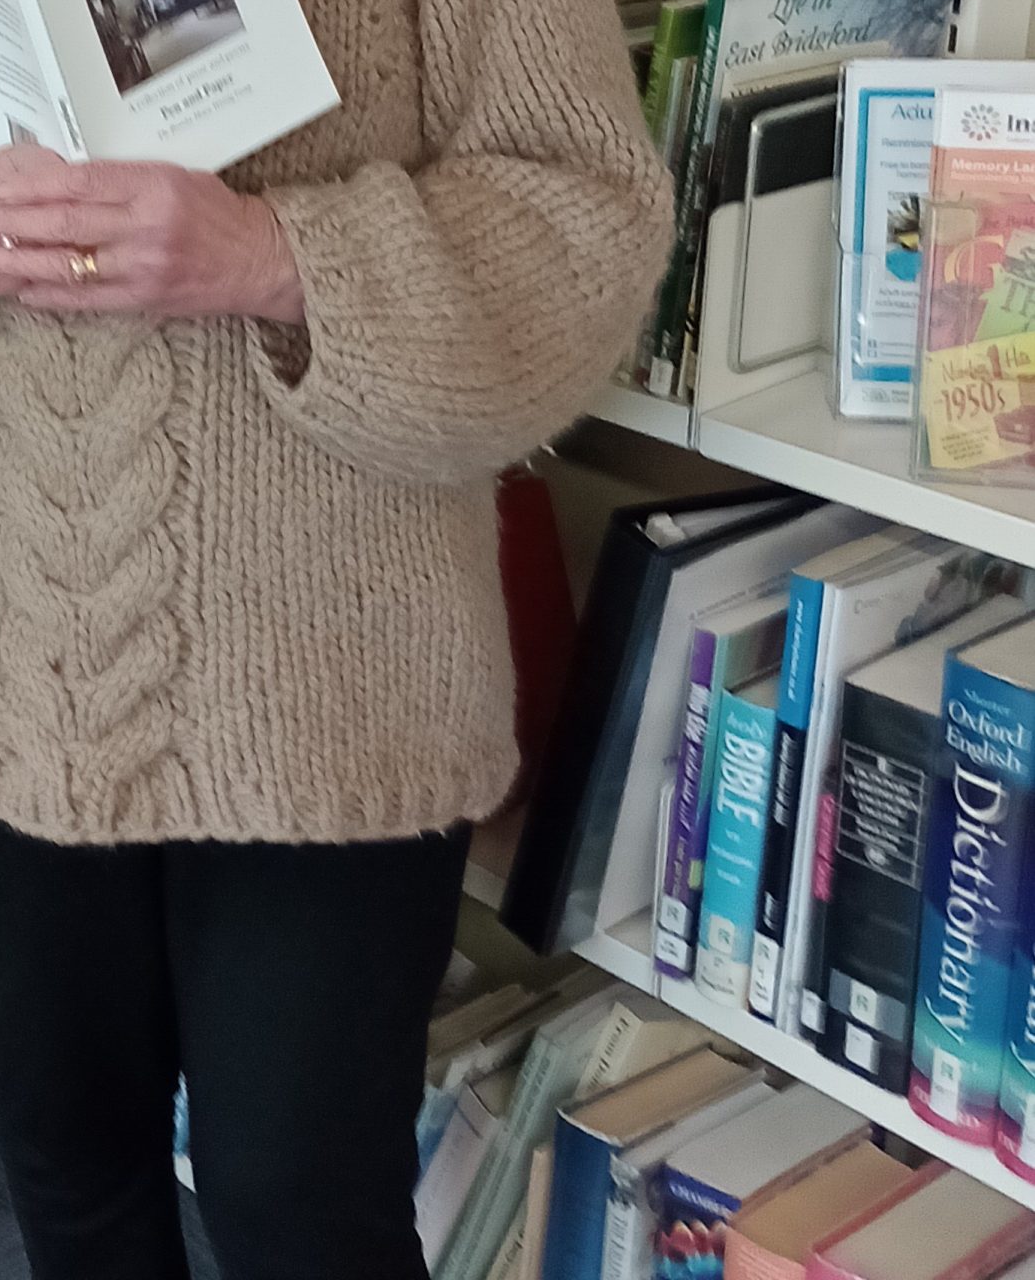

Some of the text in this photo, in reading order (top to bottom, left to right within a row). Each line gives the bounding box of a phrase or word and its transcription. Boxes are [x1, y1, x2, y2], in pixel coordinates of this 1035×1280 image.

[724, 17, 873, 70] East Bridgford
[179, 87, 204, 109] and
[951, 158, 1010, 175] Memory
[986, 344, 1003, 380] 1
[941, 380, 1006, 422] 1950s
[947, 699, 1027, 747] Oxford
[945, 726, 1027, 773] English
[719, 731, 769, 823] BIBLE
[924, 760, 1008, 1046] Dictionary
[603, 1017, 630, 1056] From
